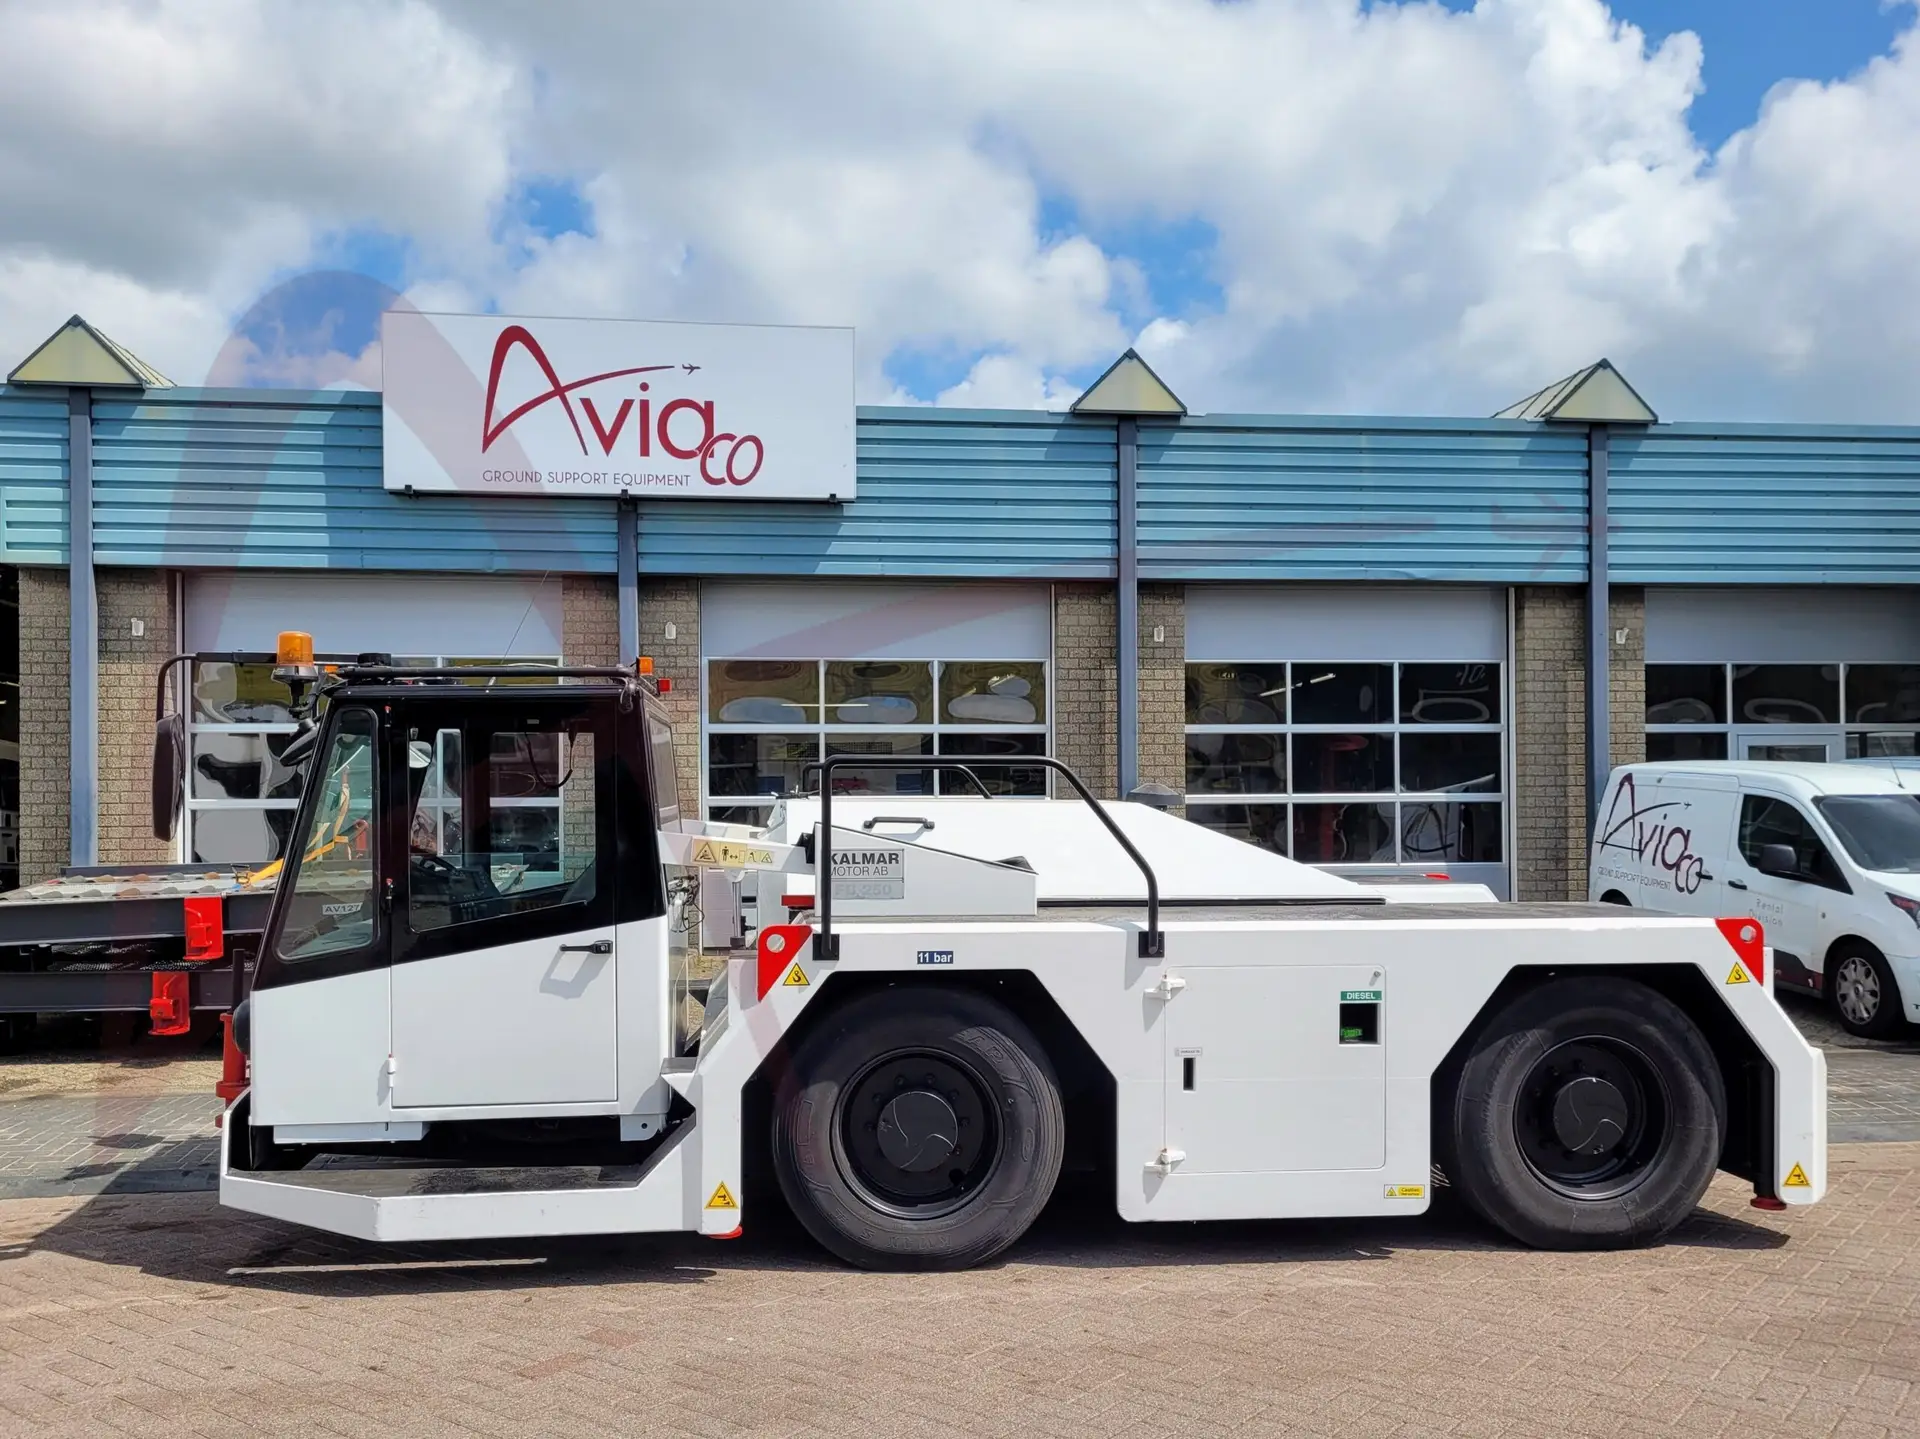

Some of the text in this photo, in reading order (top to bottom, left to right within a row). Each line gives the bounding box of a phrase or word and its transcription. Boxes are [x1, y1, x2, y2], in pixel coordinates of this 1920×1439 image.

[482, 470, 691, 487] GROUND SUPPORT EQUIPMENT
[831, 852, 900, 865] KALMAR
[873, 866, 889, 876] AB
[1614, 870, 1639, 882] SUPPORT
[1640, 874, 1672, 891] EQUIPMENT
[324, 904, 359, 913] AV127
[918, 952, 953, 963] 11 bar
[1346, 992, 1376, 1000] DIESEL
